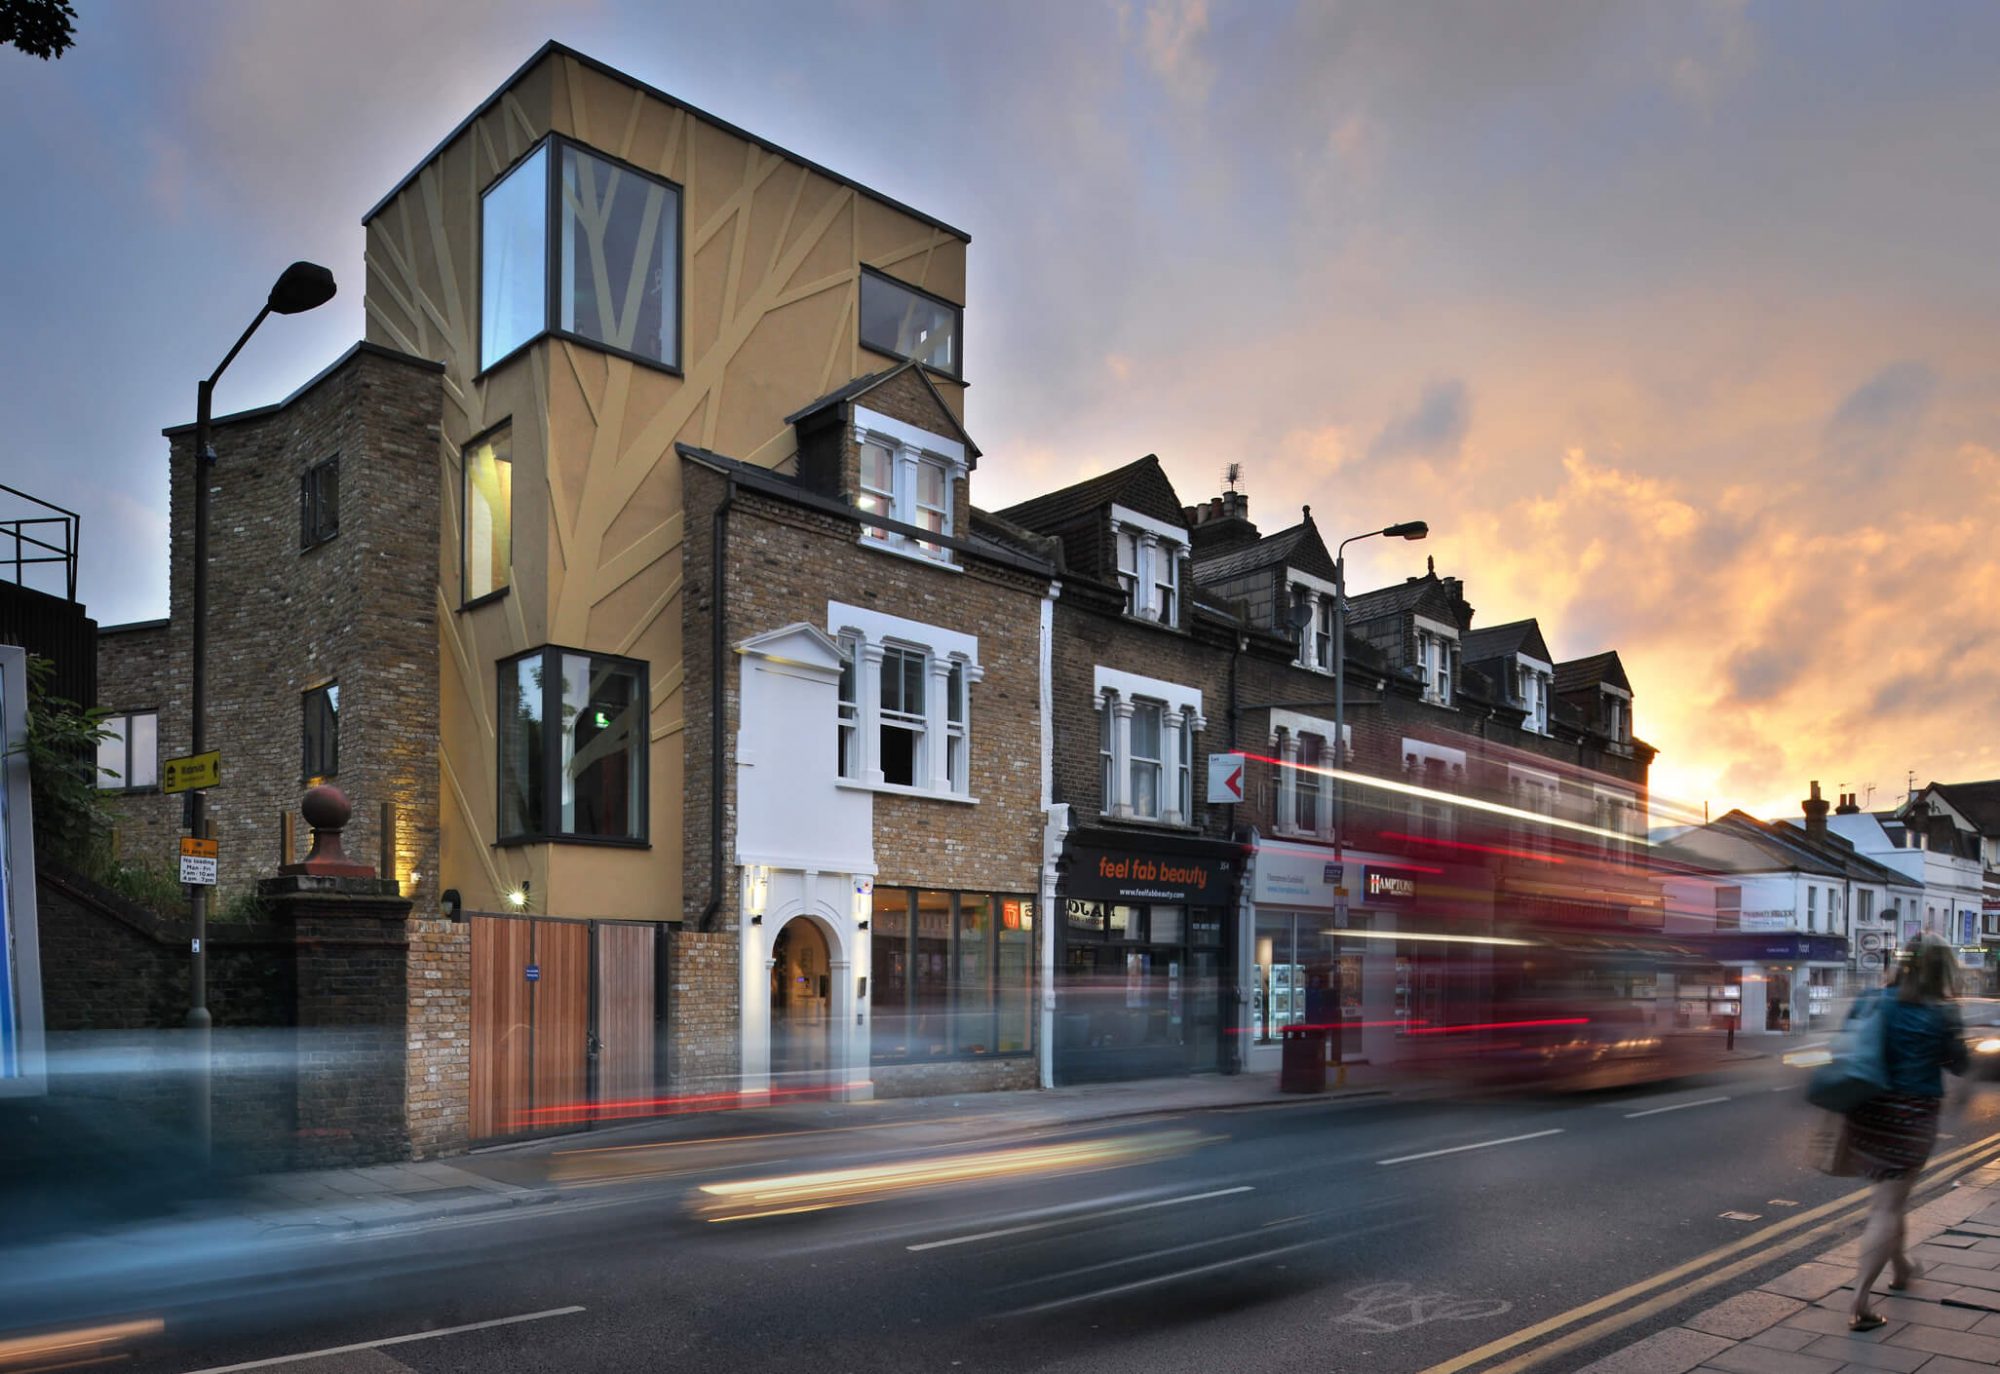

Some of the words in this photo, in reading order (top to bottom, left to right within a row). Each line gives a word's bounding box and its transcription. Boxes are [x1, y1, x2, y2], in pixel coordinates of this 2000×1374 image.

[193, 858, 215, 866] loading
[1099, 857, 1129, 878] feel
[1132, 859, 1157, 881] fab
[1159, 862, 1208, 890] beauty
[1119, 888, 1185, 900] www.feelfabbeauty.com
